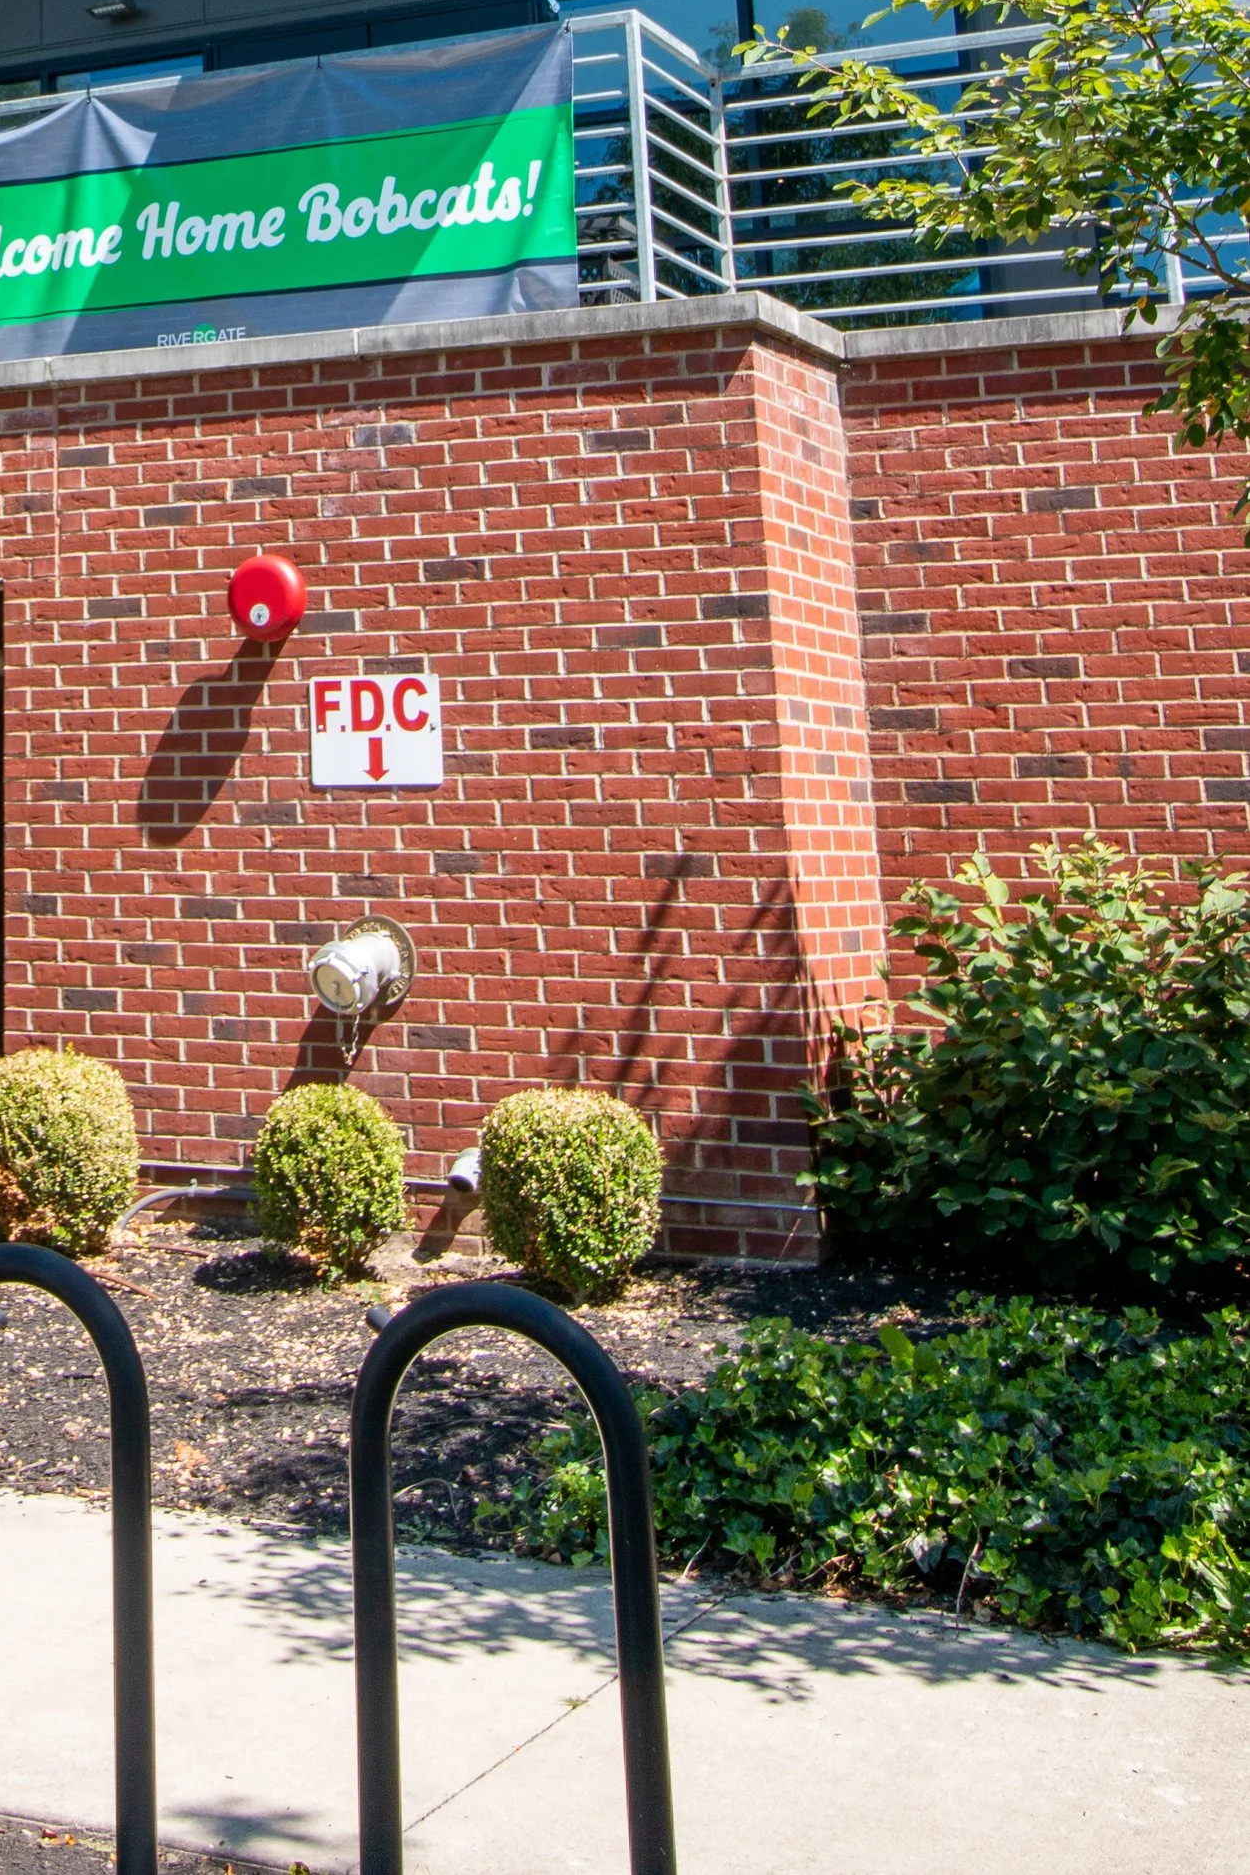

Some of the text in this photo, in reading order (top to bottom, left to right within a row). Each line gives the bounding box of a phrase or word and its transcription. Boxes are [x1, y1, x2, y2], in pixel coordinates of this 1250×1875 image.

[136, 201, 286, 260] Home
[298, 159, 543, 243] Bobcats!
[157, 326, 246, 347] RIVERGATE
